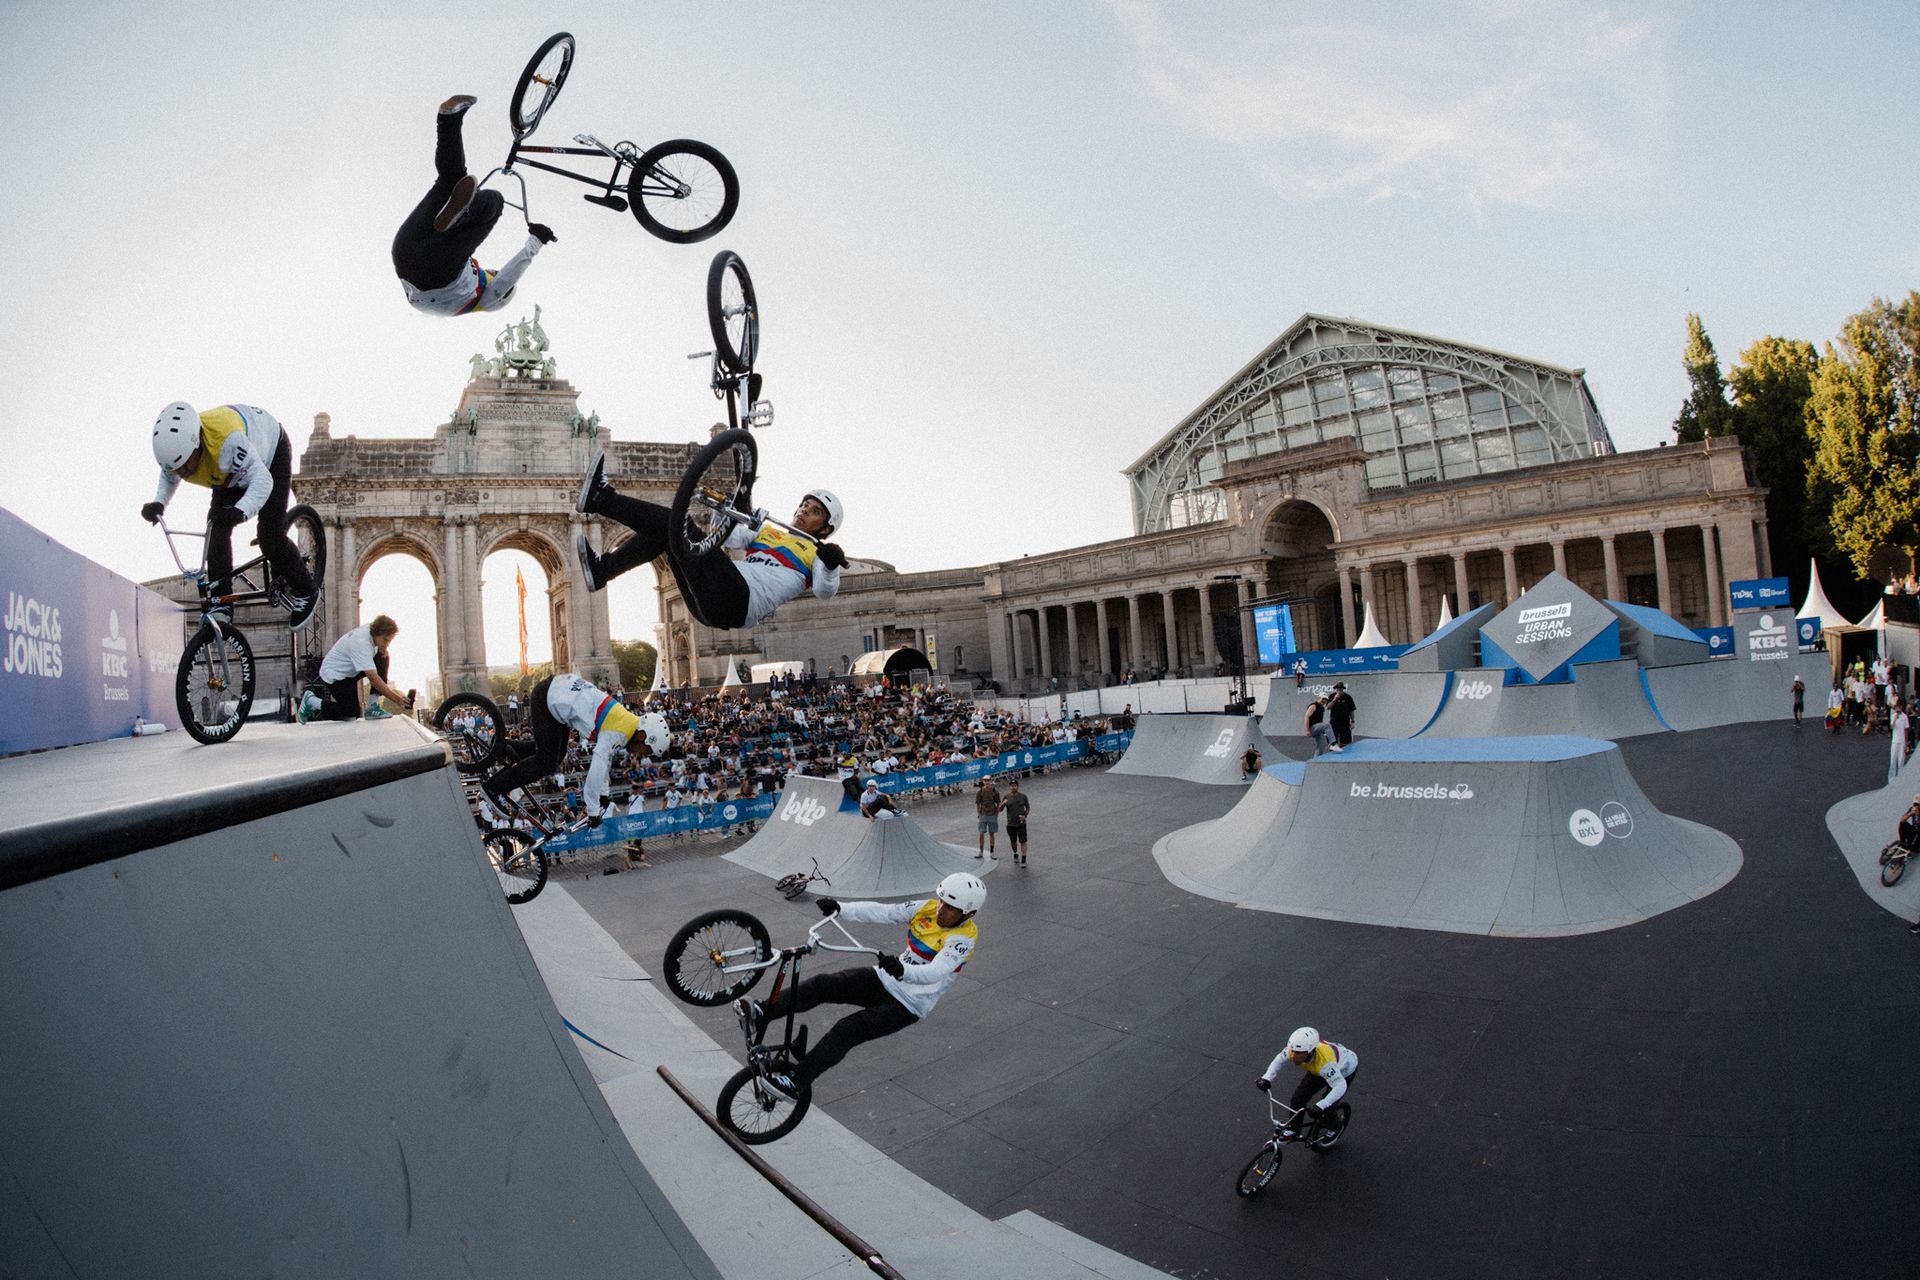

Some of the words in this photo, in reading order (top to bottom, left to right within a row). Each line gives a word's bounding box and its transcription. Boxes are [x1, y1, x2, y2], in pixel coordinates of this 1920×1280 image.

[1522, 605, 1568, 620] brussels
[1515, 626, 1572, 644] SESSIONS
[1525, 619, 1565, 633] URBAN
[1749, 634, 1788, 650] KBC
[4, 632, 63, 679] JONES
[1750, 650, 1789, 661] Brussels
[102, 652, 128, 678] KBC
[103, 683, 129, 701] Brussels
[1455, 679, 1493, 700] lotto
[1350, 781, 1449, 800] be.brussels
[780, 791, 827, 827] lotto
[1578, 826, 1600, 839] BXL
